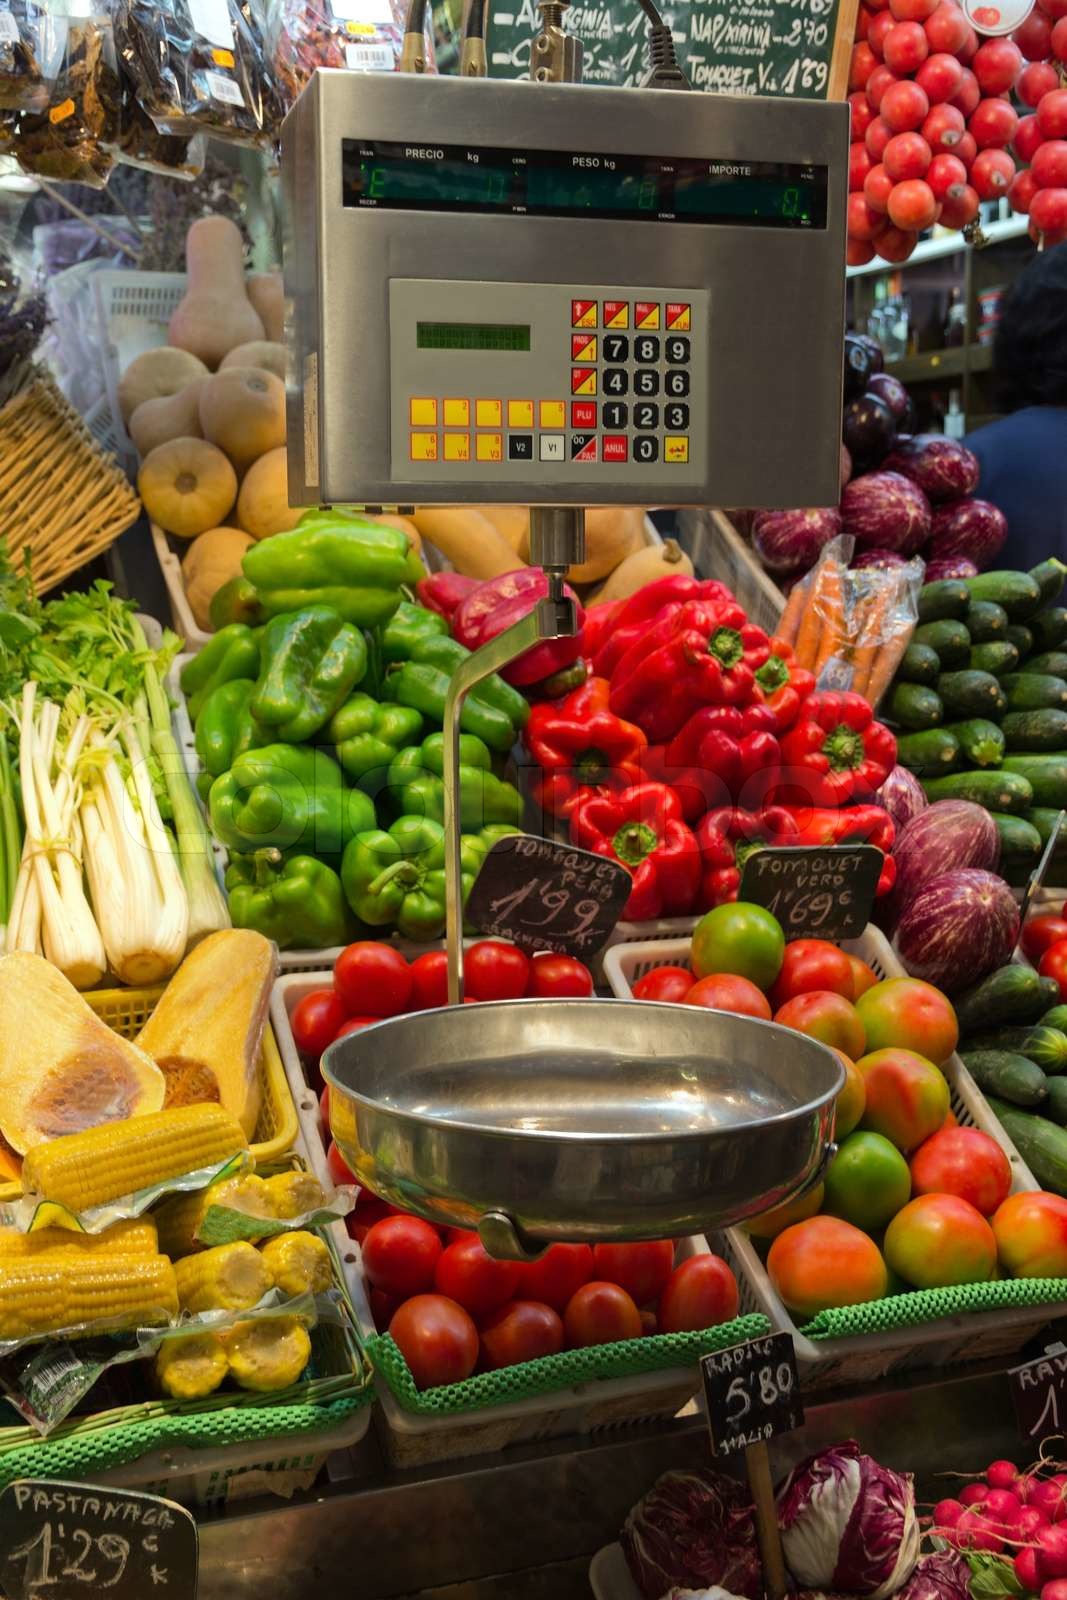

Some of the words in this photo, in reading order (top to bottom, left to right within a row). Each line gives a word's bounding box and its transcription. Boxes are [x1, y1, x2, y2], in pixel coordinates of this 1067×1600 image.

[405, 148, 444, 160] PRECIO
[467, 152, 480, 163] kg
[572, 157, 600, 168] PESO
[604, 159, 616, 170] kg
[709, 165, 751, 176] IMPORTE
[581, 318, 596, 327] ESC
[610, 340, 622, 358] 7
[641, 341, 653, 359] 8
[672, 342, 685, 360] 9
[610, 374, 622, 391] 4
[641, 374, 653, 392] 5
[672, 375, 684, 393] 6
[576, 410, 592, 420] PLU
[611, 407, 619, 424] 1
[641, 408, 653, 425] 2
[671, 408, 683, 426] 3
[425, 450, 435, 458] V5
[457, 450, 467, 458] V4
[516, 443, 526, 452] V2
[548, 444, 557, 452] V1
[604, 444, 625, 454] ANUL
[640, 441, 652, 458] 0
[725, 1362, 794, 1423] 5'80
[13, 1485, 176, 1530] PASTANAGA
